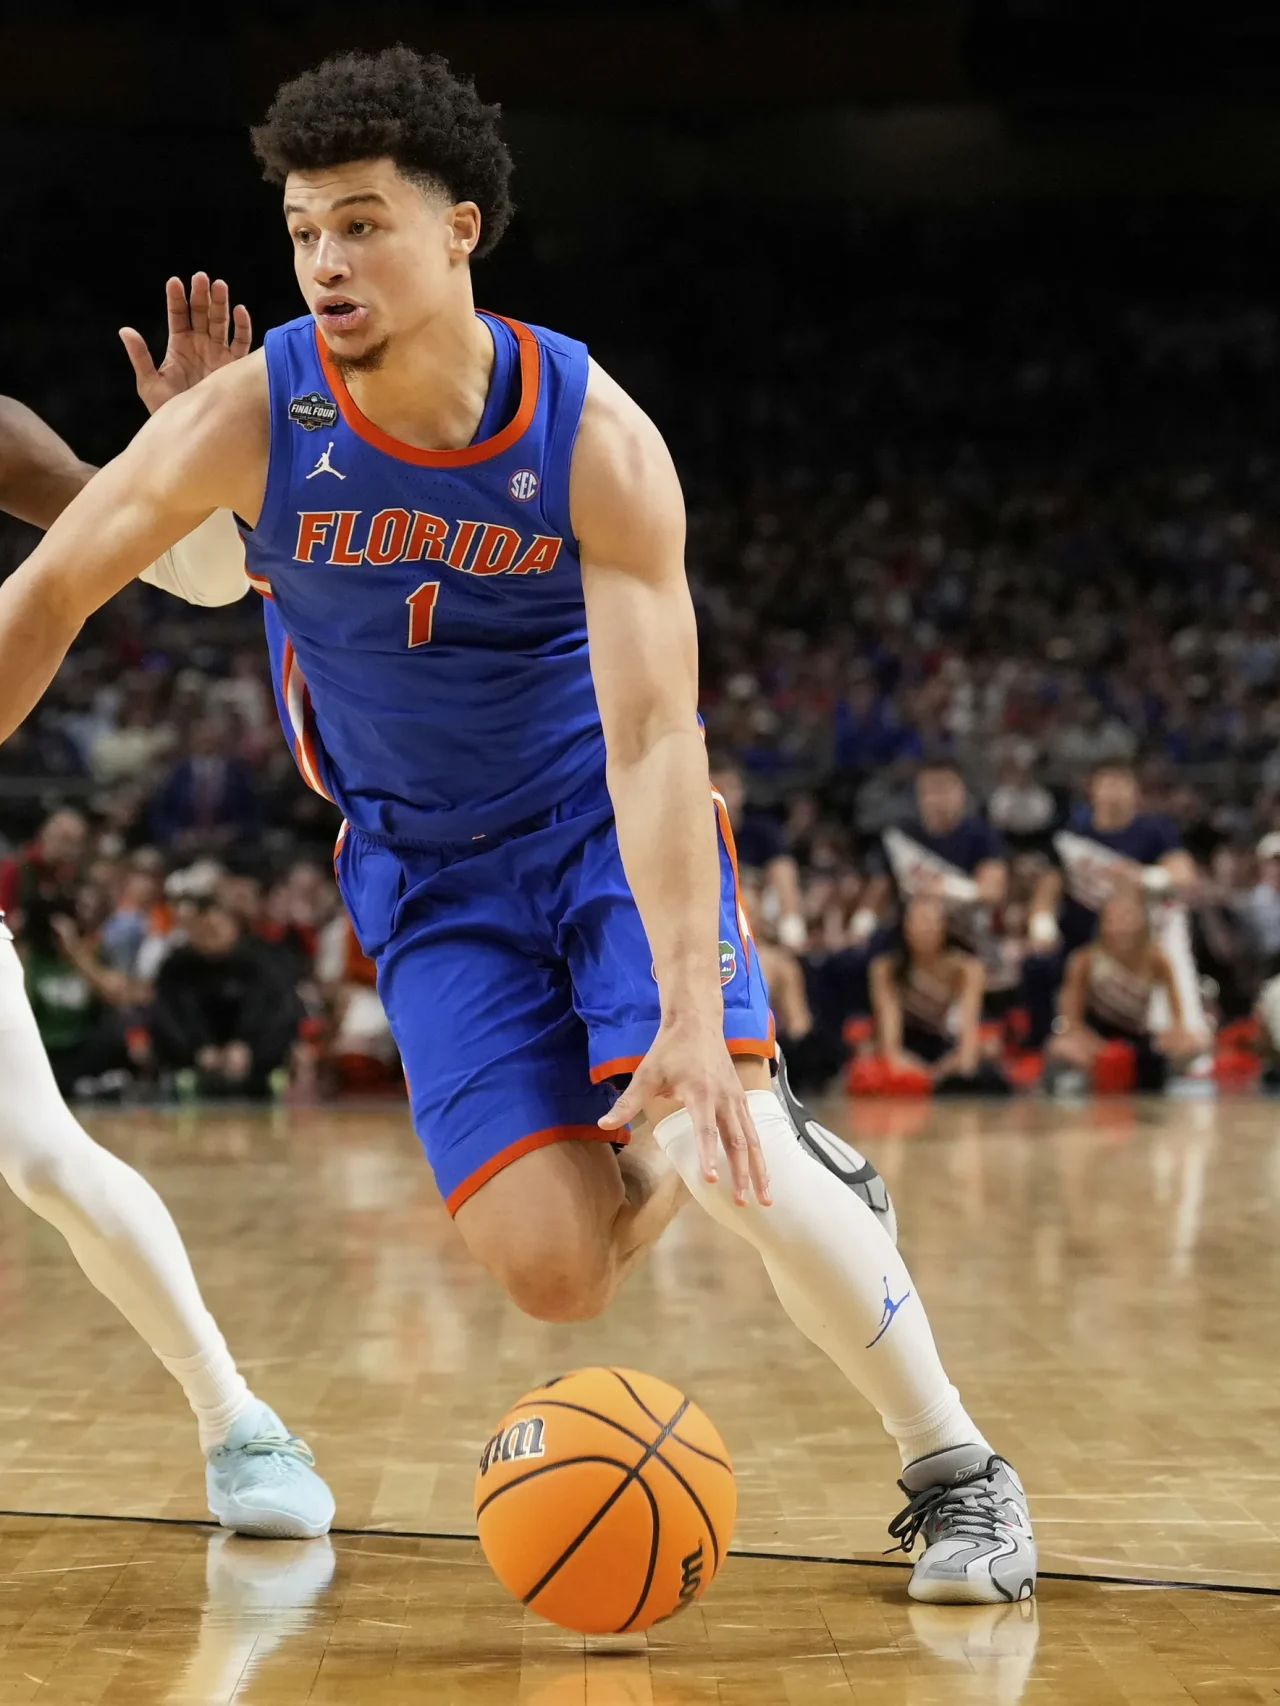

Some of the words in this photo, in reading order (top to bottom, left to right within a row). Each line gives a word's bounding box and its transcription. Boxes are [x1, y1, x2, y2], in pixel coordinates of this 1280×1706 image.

[291, 403, 312, 415] FINAL
[312, 407, 335, 418] FOUR
[510, 471, 537, 499] SEC
[292, 508, 562, 576] FLORIDA
[405, 581, 440, 649] 1
